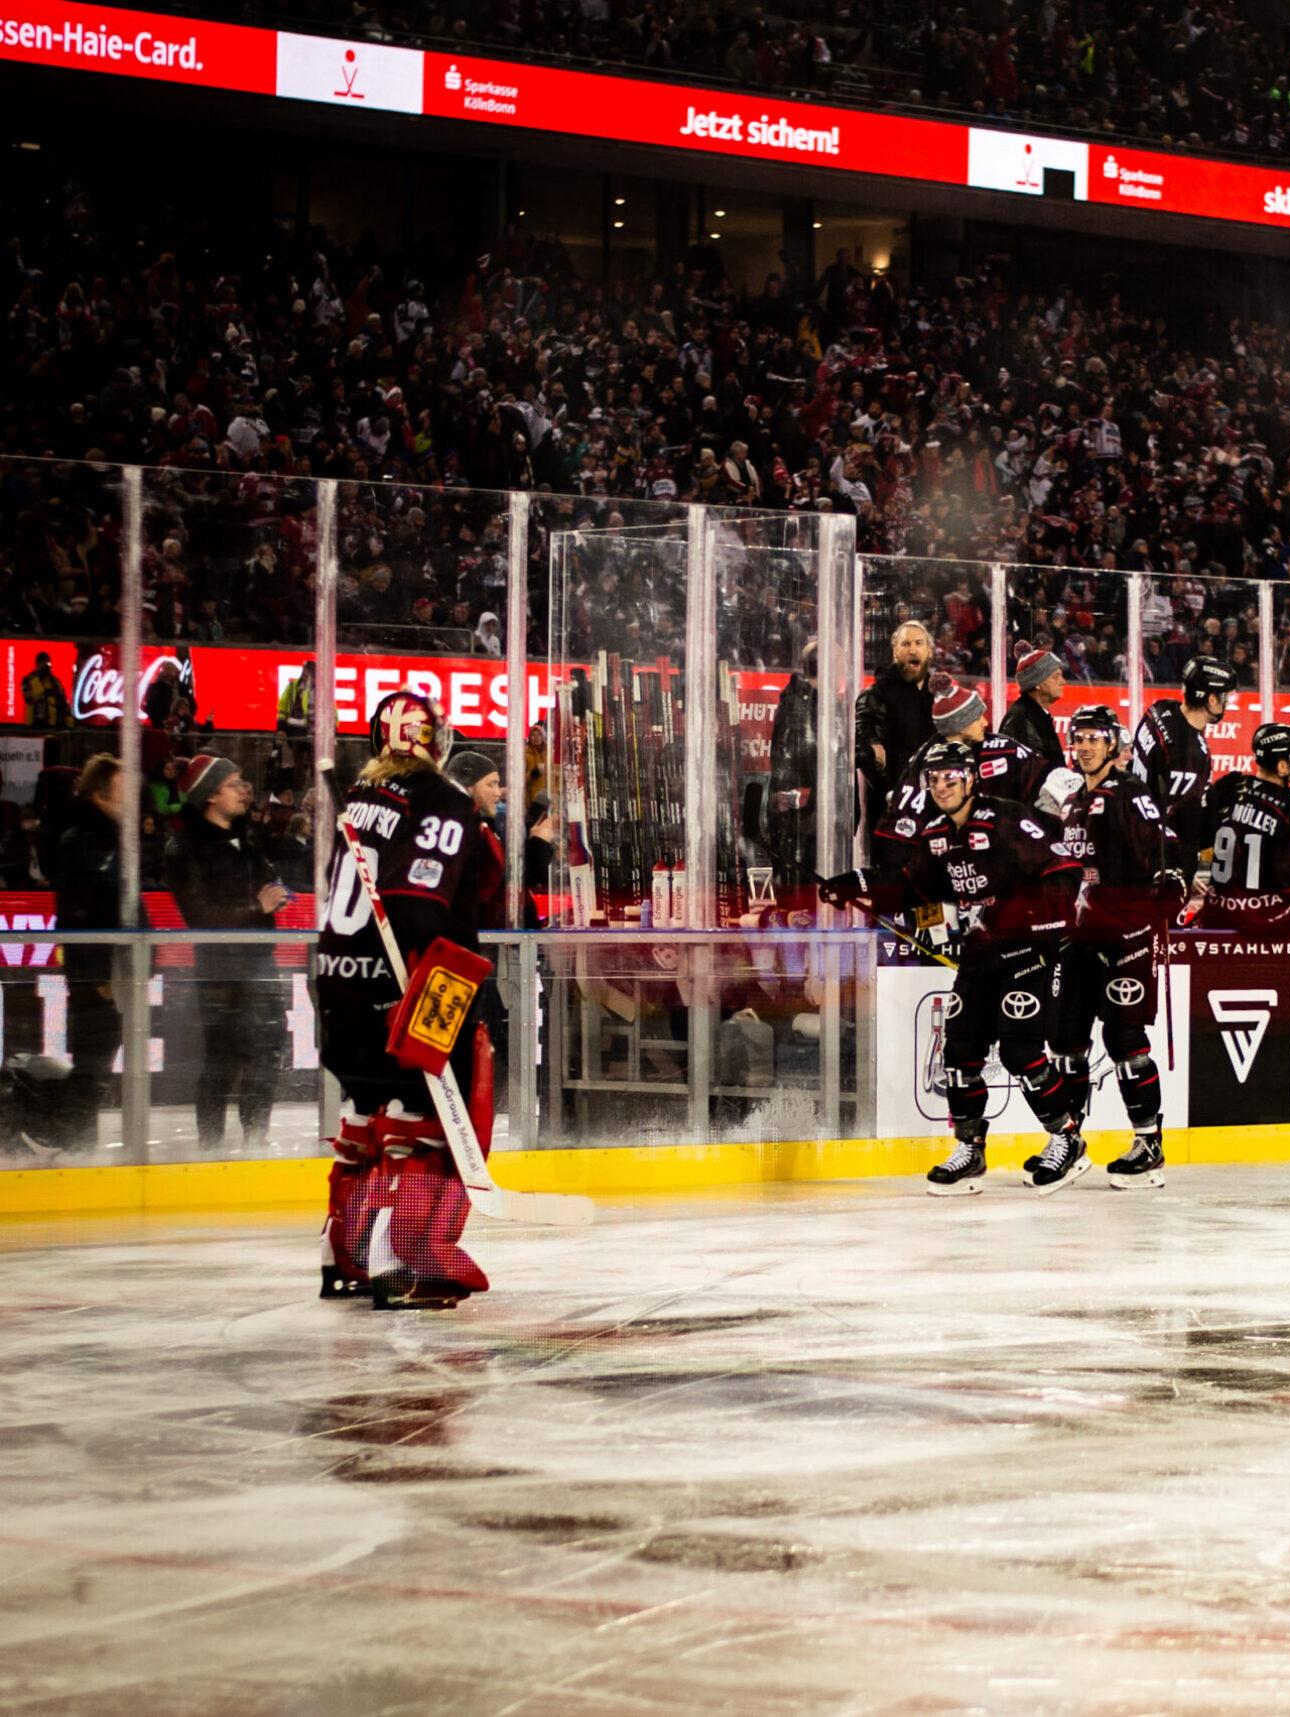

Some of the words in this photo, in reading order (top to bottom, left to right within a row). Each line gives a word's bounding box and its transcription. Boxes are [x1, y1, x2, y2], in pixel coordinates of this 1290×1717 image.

[0, 20, 204, 71] sen-Haie-Card.
[680, 106, 743, 141] Jetzt
[747, 115, 839, 155] sichern!
[898, 784, 928, 815] 74
[1169, 770, 1197, 796] 77
[1132, 795, 1160, 820] 15
[1231, 803, 1278, 836] MÜLLER
[415, 815, 464, 856] 30
[1210, 825, 1264, 890] 91
[1220, 894, 1283, 911] TOYOTA
[422, 983, 447, 1029] Radio
[456, 1126, 481, 1173] Medical
